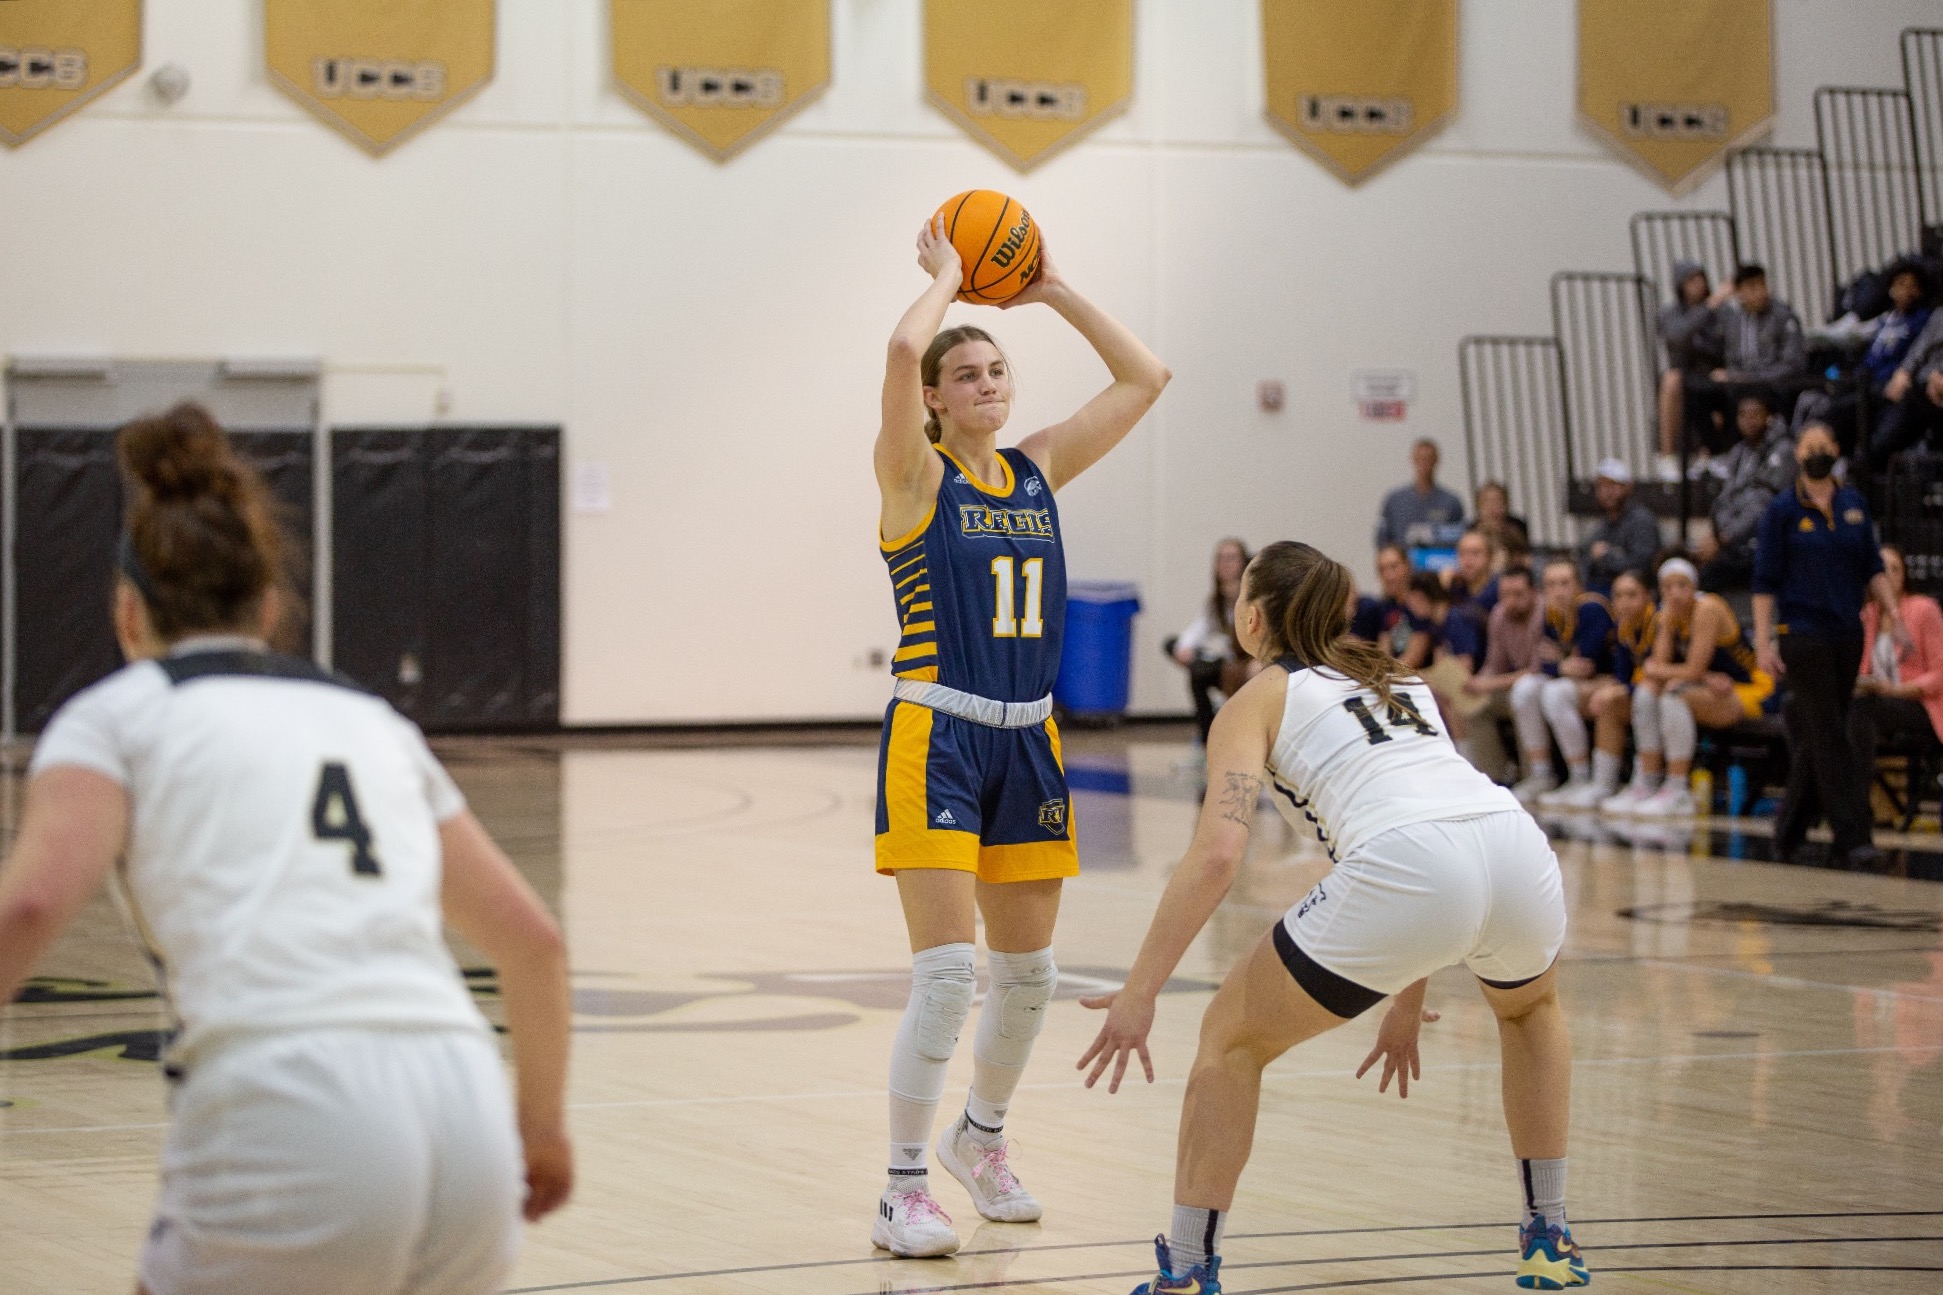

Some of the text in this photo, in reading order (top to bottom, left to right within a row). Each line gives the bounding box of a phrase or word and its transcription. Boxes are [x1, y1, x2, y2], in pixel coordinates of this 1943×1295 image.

[990, 209, 1031, 269] Wilson
[991, 556, 1043, 637] 11
[1343, 692, 1439, 746] 14
[312, 760, 382, 875] 4
